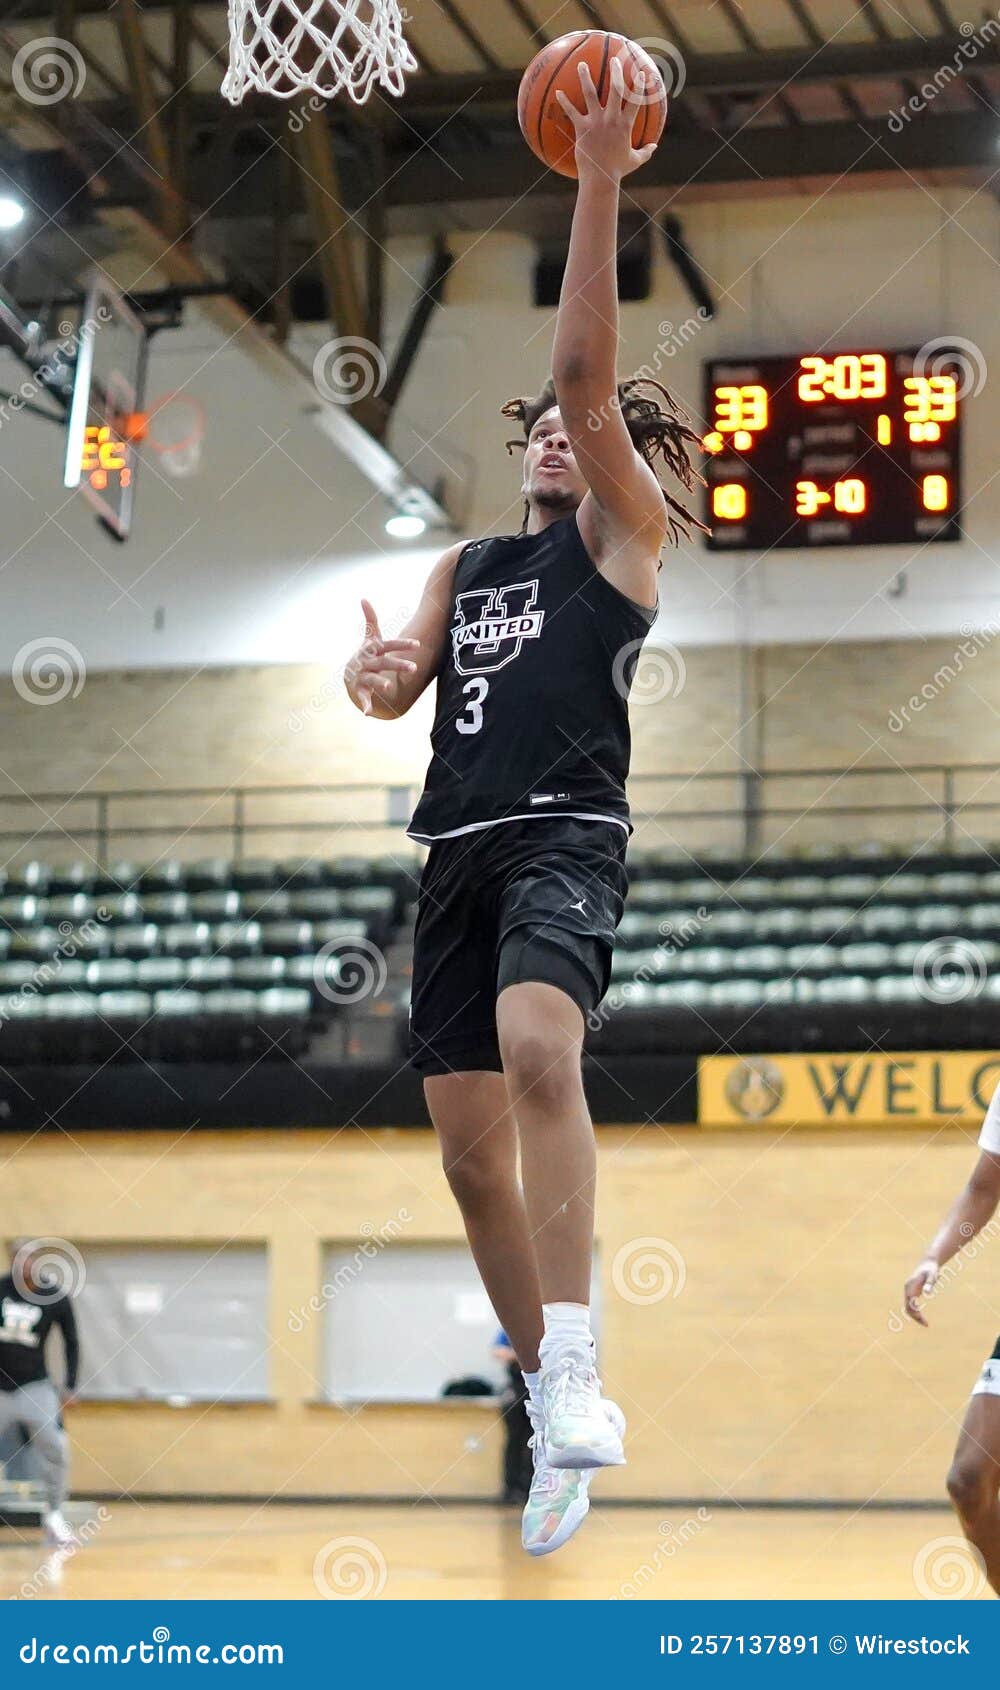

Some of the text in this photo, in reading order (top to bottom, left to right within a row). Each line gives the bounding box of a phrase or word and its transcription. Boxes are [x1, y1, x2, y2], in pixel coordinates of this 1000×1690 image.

[798, 354, 887, 402] 2:03
[903, 376, 956, 422] 33
[715, 386, 768, 432] 33
[456, 619, 534, 644] UNITED
[456, 677, 489, 734] 3
